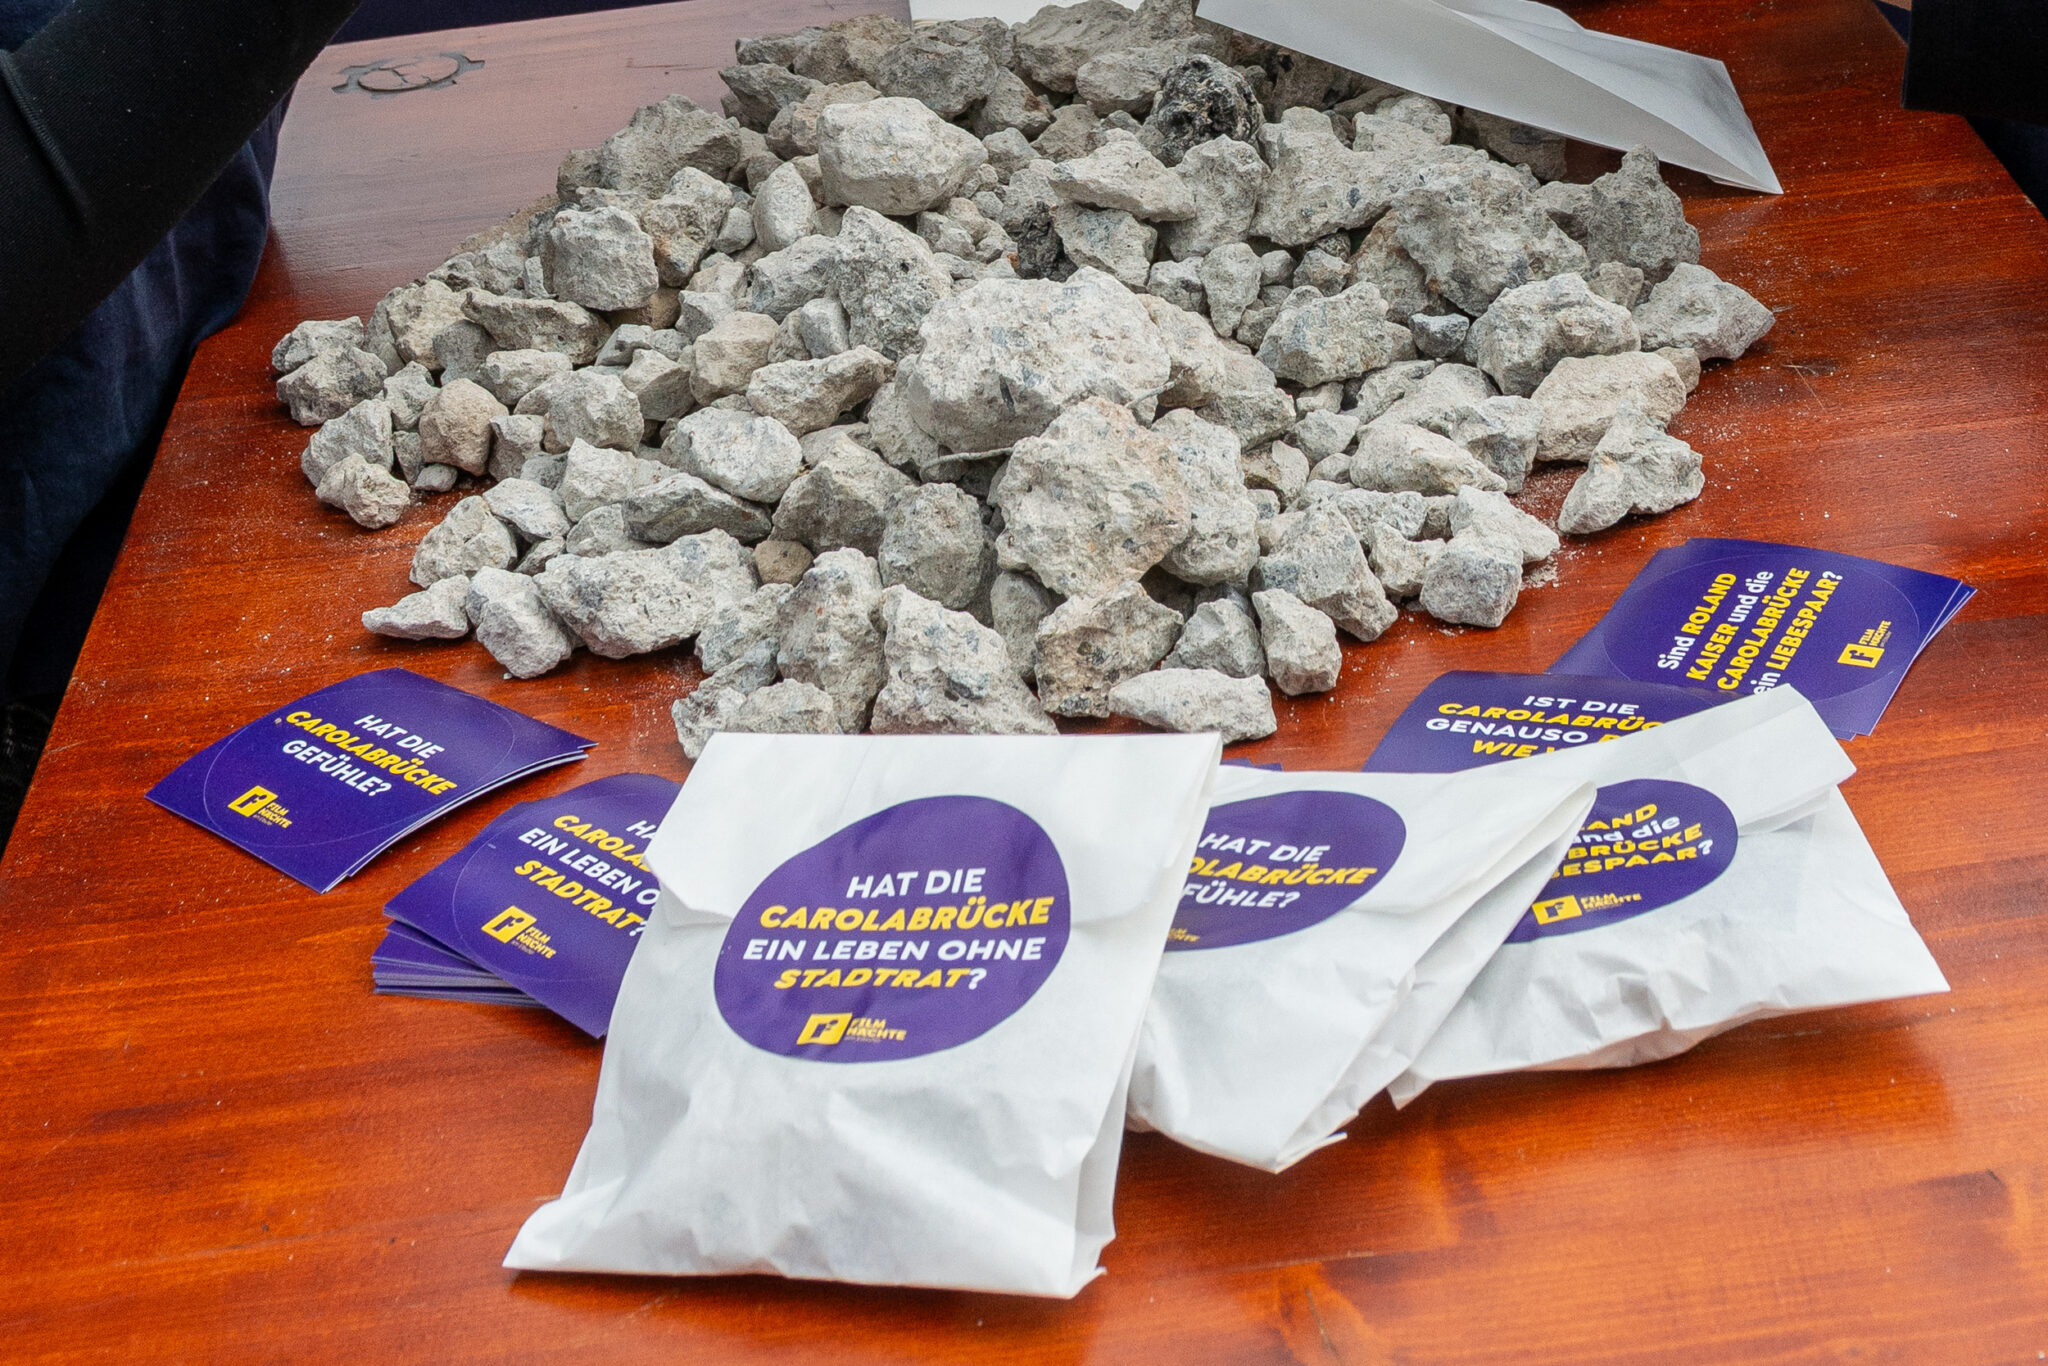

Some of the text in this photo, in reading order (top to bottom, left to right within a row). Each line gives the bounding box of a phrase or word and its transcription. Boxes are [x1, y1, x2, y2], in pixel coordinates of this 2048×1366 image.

[1657, 573, 1737, 670] Sind ROLAND
[1686, 570, 1774, 681] KAISER und die
[1717, 567, 1811, 691] CAROLABRÜCKE
[1765, 570, 1843, 671] LIEBESPAAR?
[1523, 695, 1640, 715] IST DIE
[353, 714, 445, 759] HAT DIE
[1426, 717, 1589, 744] GENAUSO
[1472, 739, 1539, 758] WIE
[282, 739, 393, 797] GEFÜHLE?
[285, 711, 458, 796] CAROLABRÜCKE
[1580, 803, 1658, 831] AND
[1632, 816, 1681, 839] die
[553, 815, 652, 873] CAROLA
[1198, 832, 1331, 863] HAT DIE
[1551, 838, 1714, 880] ESPAAR?
[1567, 822, 1704, 860] BRÜCKE
[518, 827, 643, 895] EIN LEBEN
[1189, 856, 1378, 886] OLABRÜCKE
[846, 867, 987, 899] HAT DIE
[1182, 880, 1301, 909] FÜHLE?
[760, 896, 1055, 932] CAROLABRÜCKE
[742, 937, 1047, 961] EIN LEBEN OHNE
[773, 968, 988, 990] STADTRAT?
